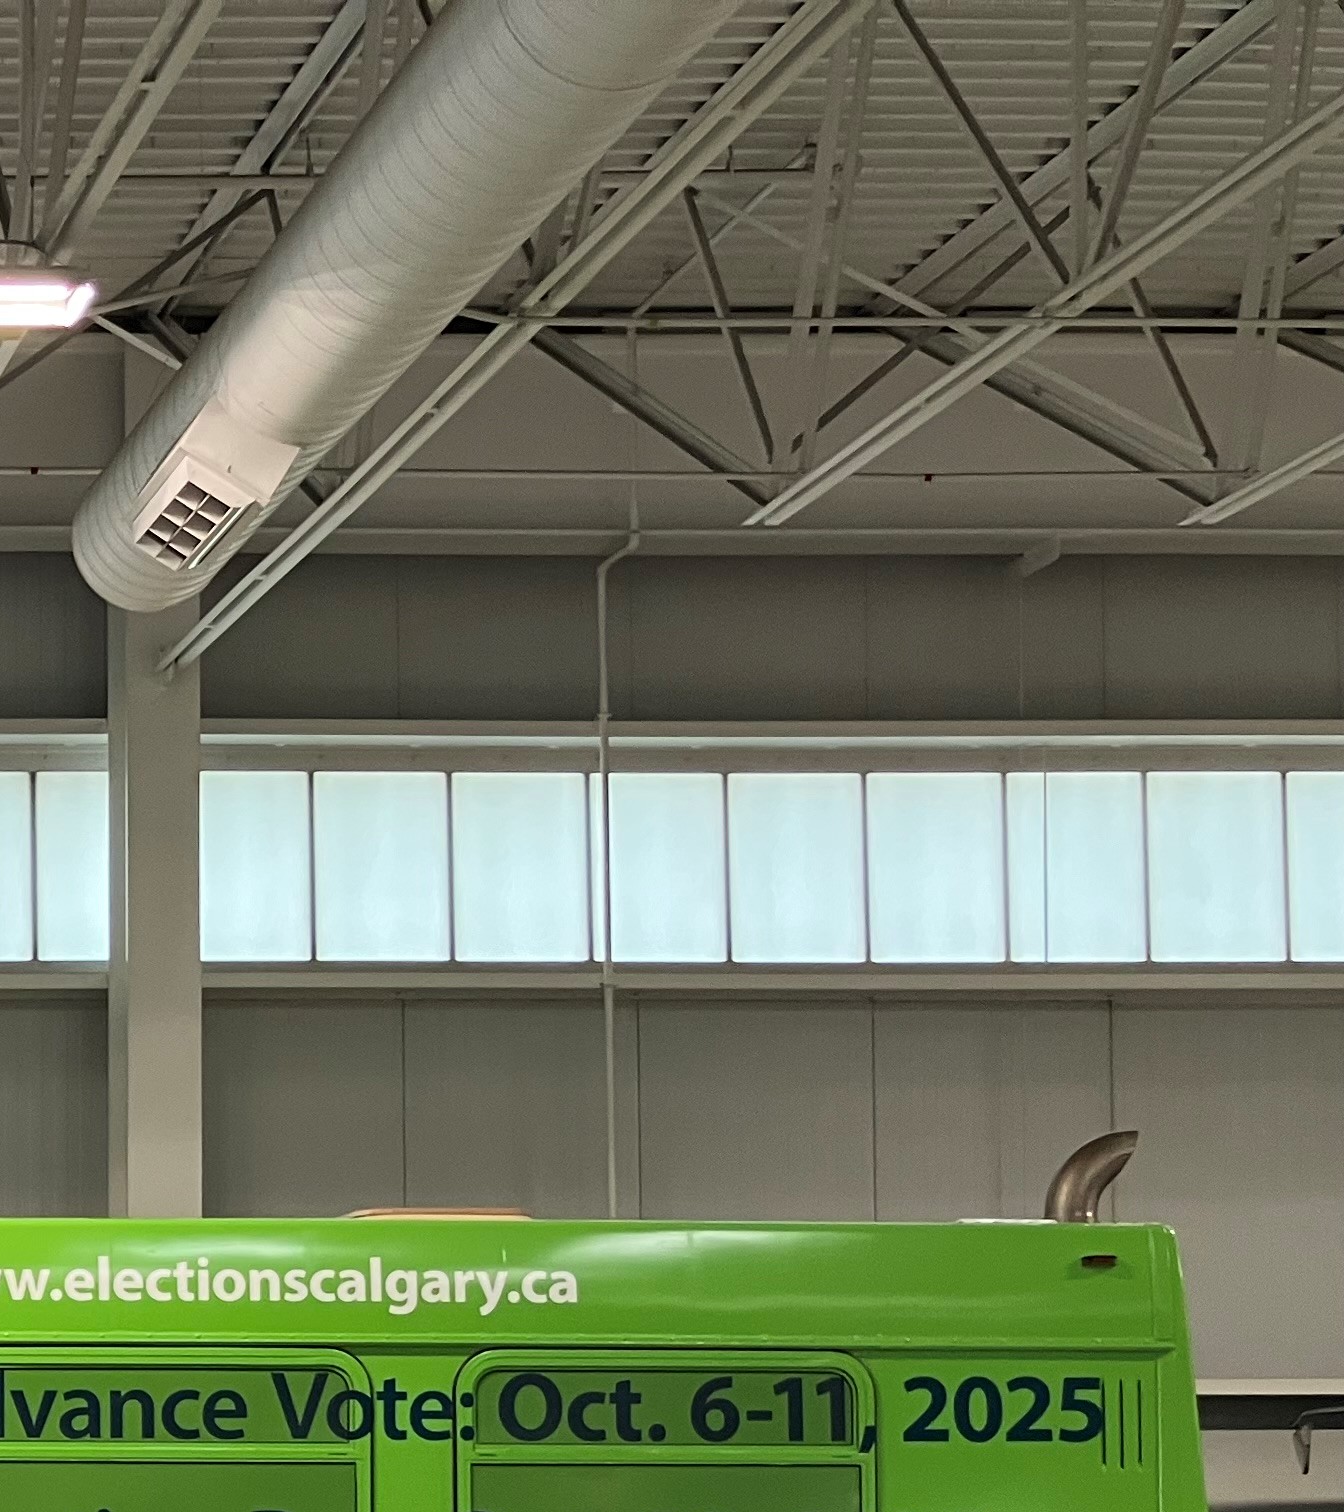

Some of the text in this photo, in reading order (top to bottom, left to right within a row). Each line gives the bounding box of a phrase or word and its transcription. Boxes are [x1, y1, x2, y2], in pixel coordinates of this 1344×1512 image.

[272, 1372, 475, 1442] Vote:
[498, 1373, 667, 1443] Oct.
[690, 1375, 877, 1453] 6-11,
[902, 1376, 1105, 1444] 2025
